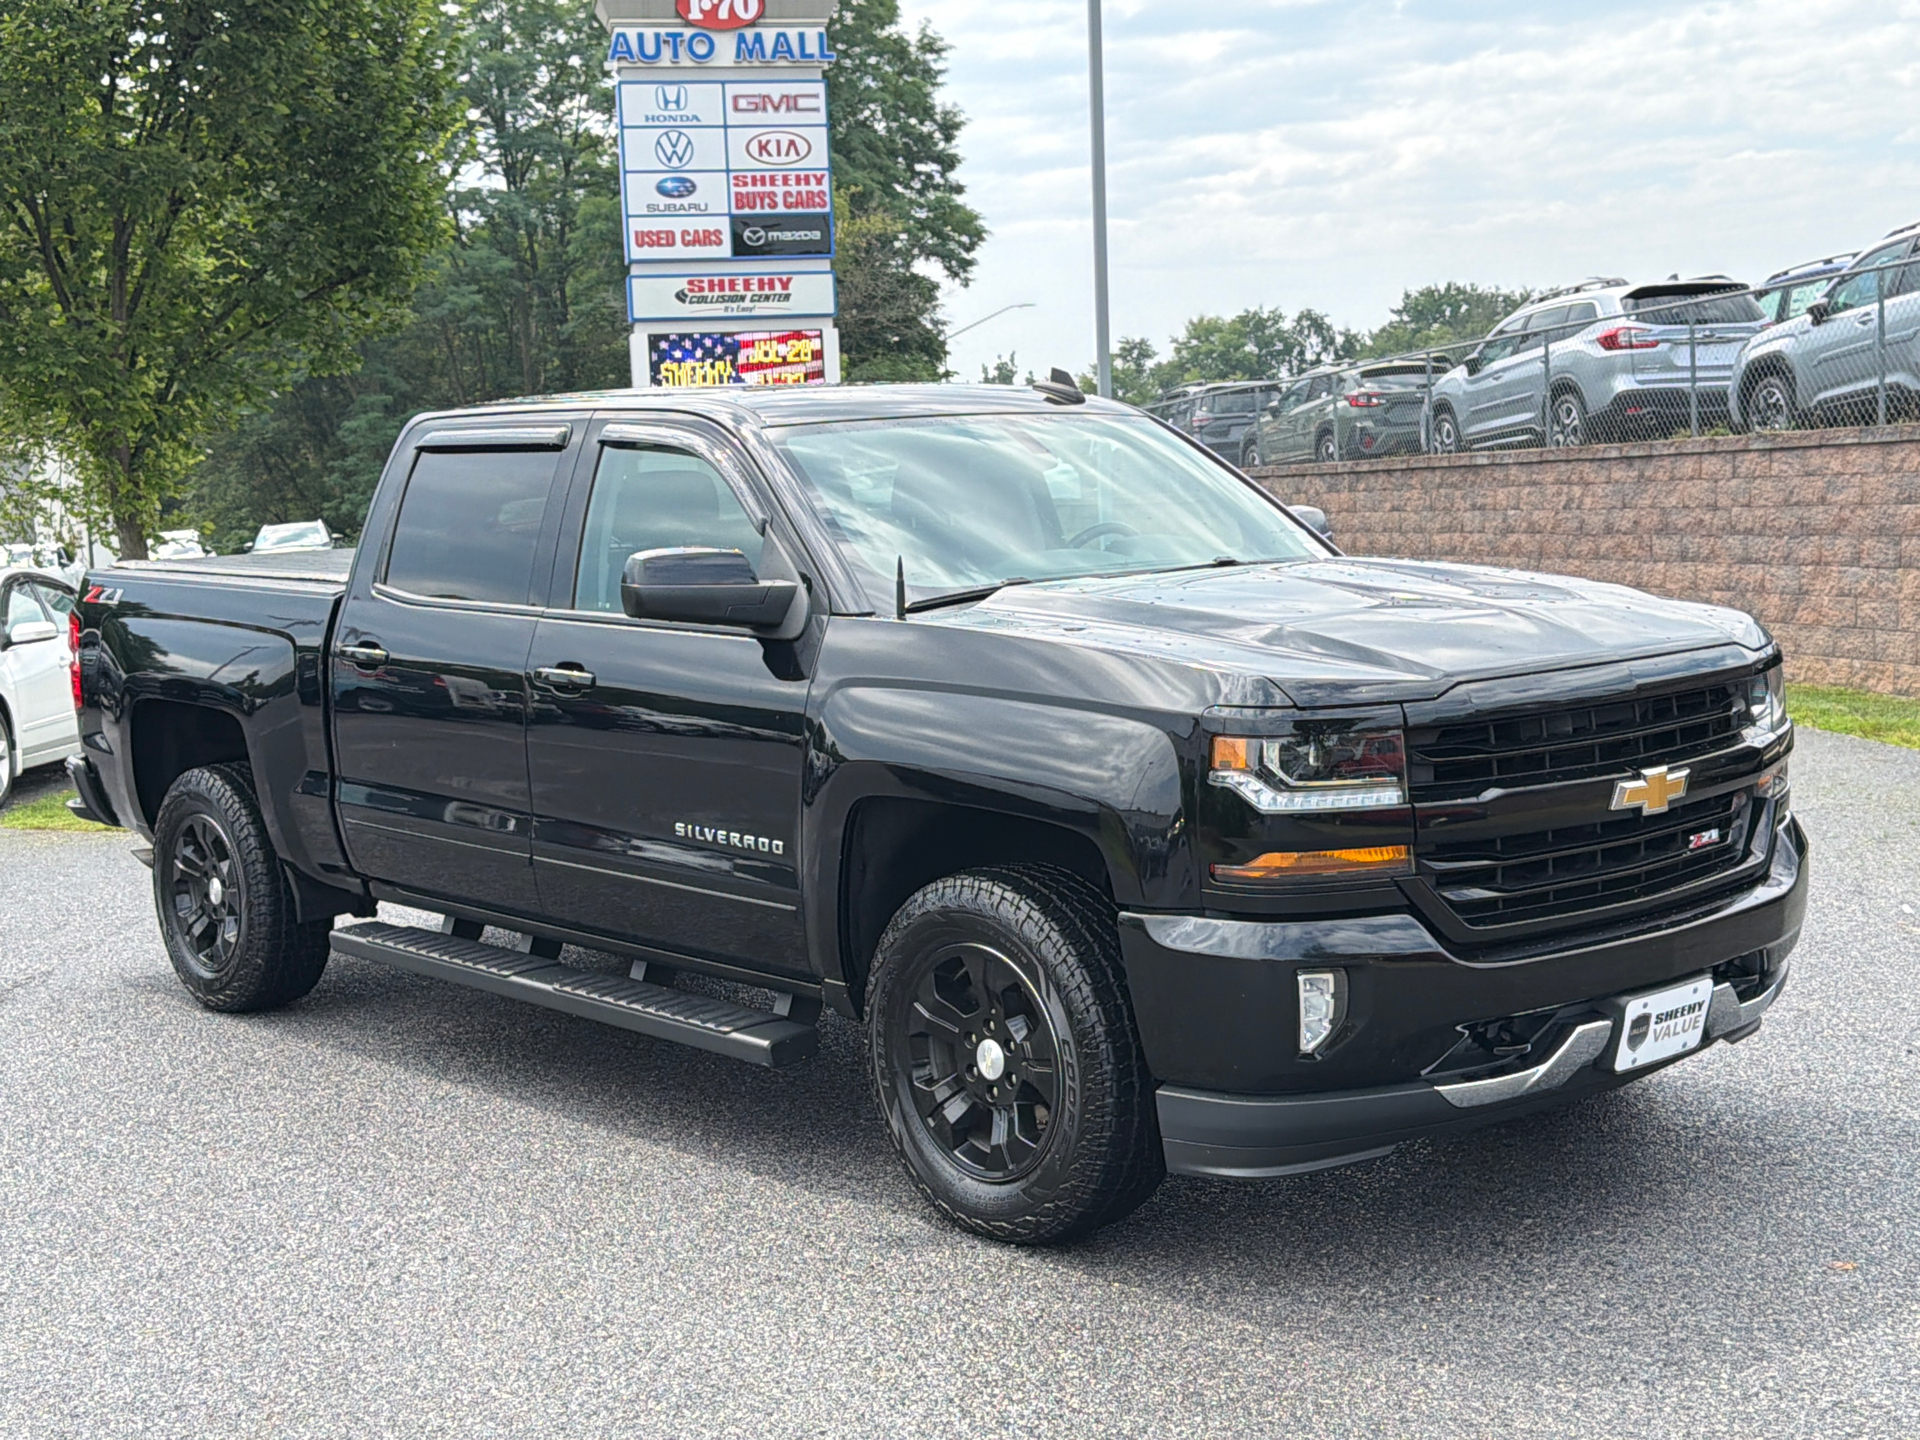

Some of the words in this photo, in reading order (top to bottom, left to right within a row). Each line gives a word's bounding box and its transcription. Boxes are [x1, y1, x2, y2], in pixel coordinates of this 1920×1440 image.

[608, 31, 716, 62] AUTO
[735, 31, 837, 62] MALL
[731, 93, 821, 113] GMC
[644, 113, 702, 123] HONDA
[757, 138, 801, 158] KIA
[732, 173, 827, 188] SHEEHY
[646, 202, 708, 213] SUBARU
[734, 190, 778, 211] BUYS
[782, 189, 828, 210] CARS
[633, 230, 677, 248] USED
[680, 228, 724, 247] CARS
[767, 229, 822, 241] mazda
[686, 276, 793, 294] SHEEHY
[688, 293, 746, 305] COLLISION
[749, 292, 793, 304] CENTER
[723, 304, 736, 314] It's
[736, 304, 757, 314] Easy!
[82, 586, 125, 605] Z71
[674, 821, 785, 855] SILVERADO
[1688, 828, 1720, 850] Z71
[1653, 999, 1706, 1026] SHEEHY
[1652, 1013, 1703, 1043] VALUE
